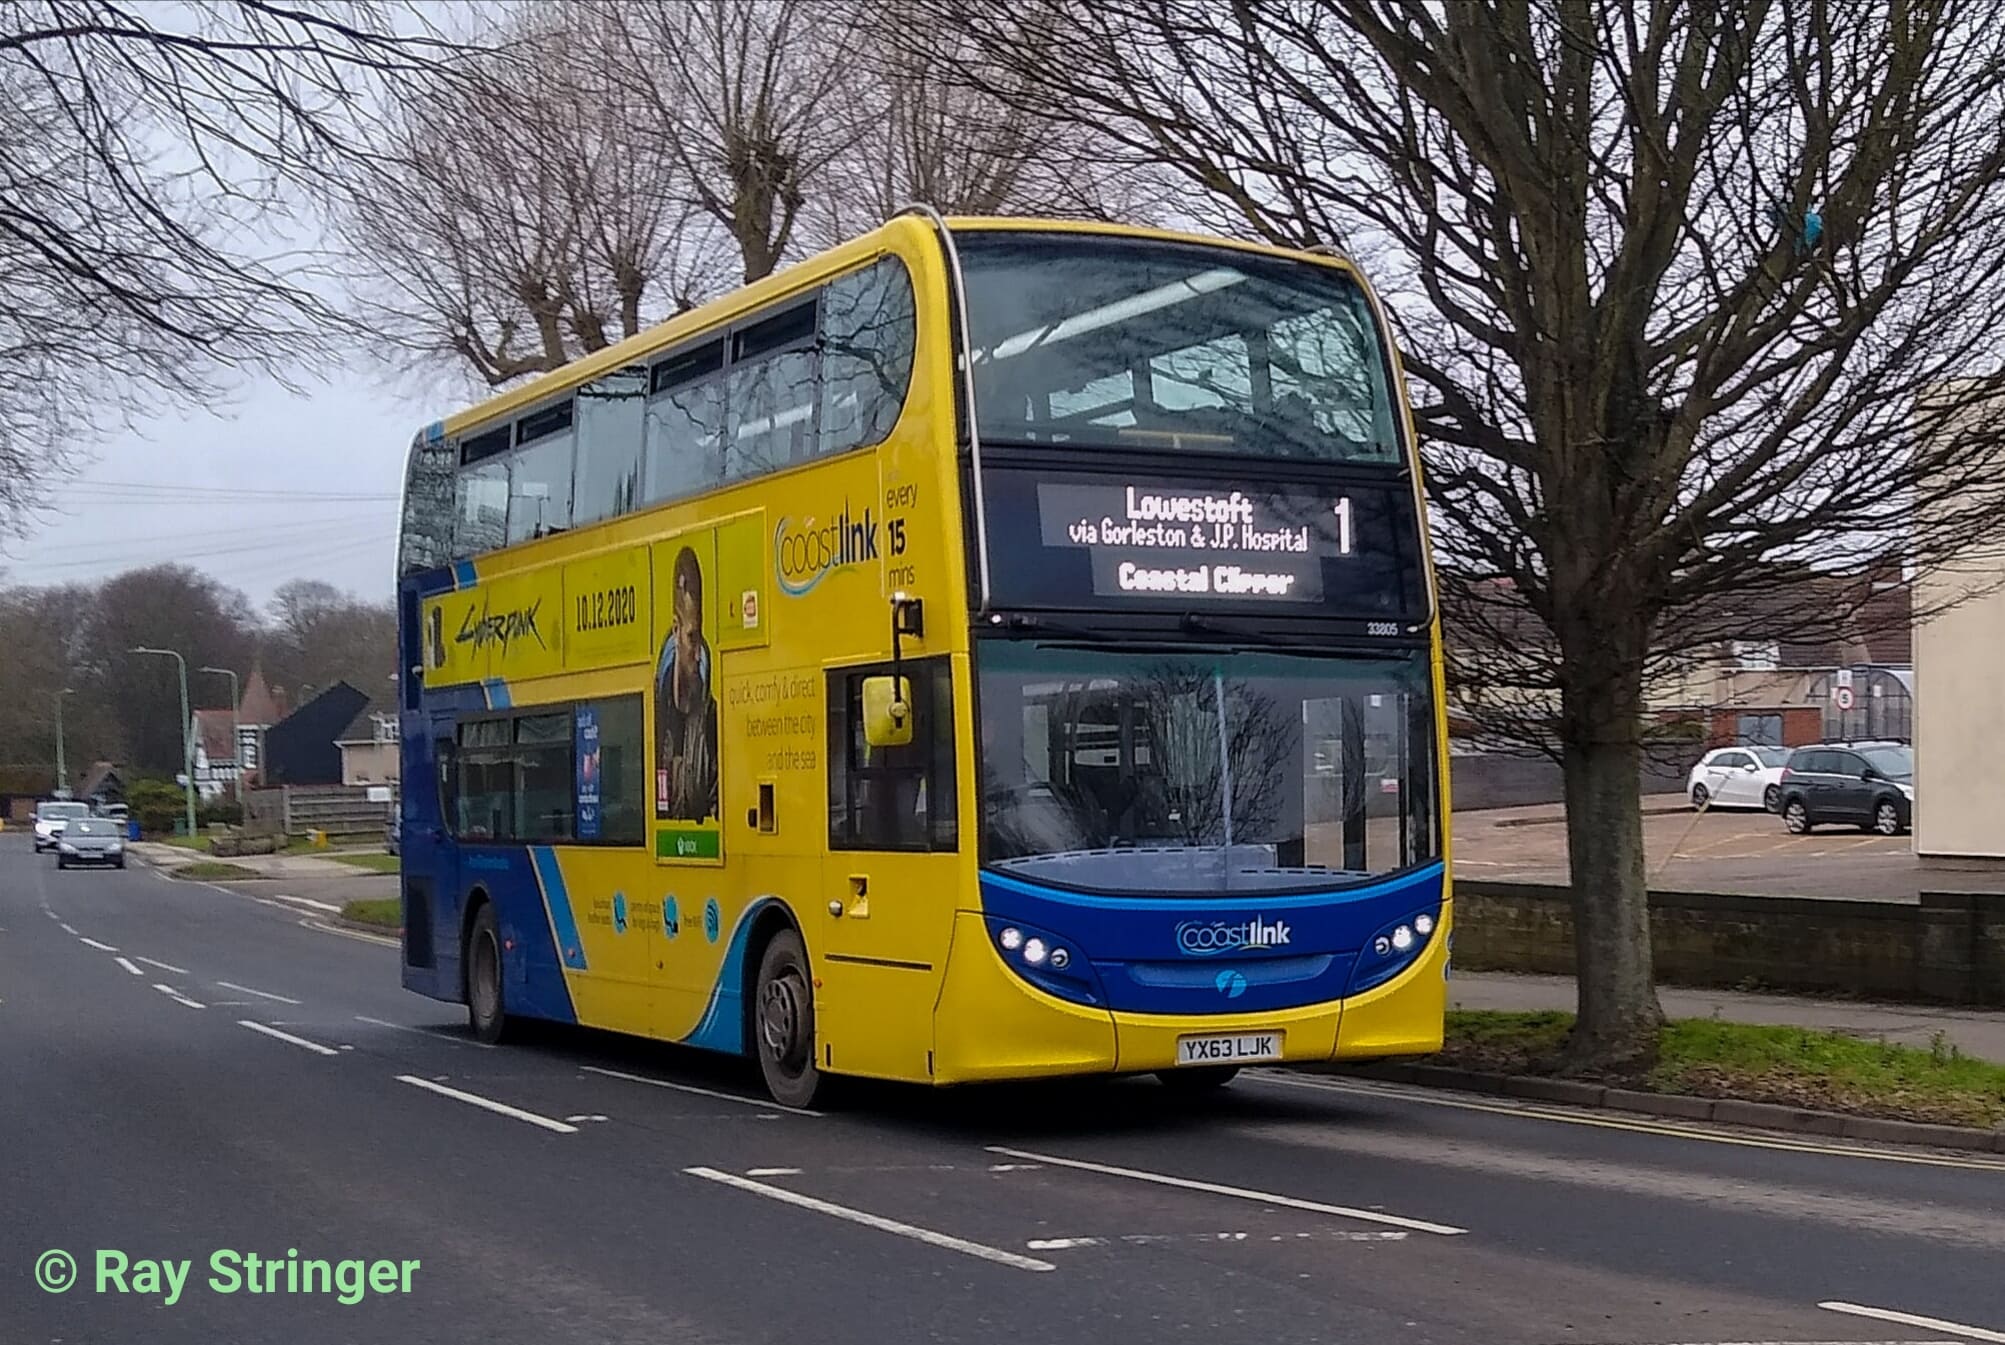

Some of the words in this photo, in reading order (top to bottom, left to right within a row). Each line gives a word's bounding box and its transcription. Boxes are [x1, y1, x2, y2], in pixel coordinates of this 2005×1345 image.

[886, 482, 918, 509] every
[1126, 486, 1253, 525] Lowestoft
[1334, 497, 1350, 555] 1
[888, 518, 906, 557] 15
[1069, 521, 1097, 545] via
[1101, 517, 1186, 548] Gorleston
[1190, 525, 1206, 547] &
[1210, 525, 1238, 551] J.P.
[1241, 525, 1308, 553] Hospital
[888, 563, 915, 588] mins
[576, 586, 636, 632] 10.12.2020
[1367, 622, 1399, 637] 33805
[1841, 693, 1849, 704] 5
[1186, 1039, 1232, 1060] YX63
[1237, 1037, 1272, 1056] LJK
